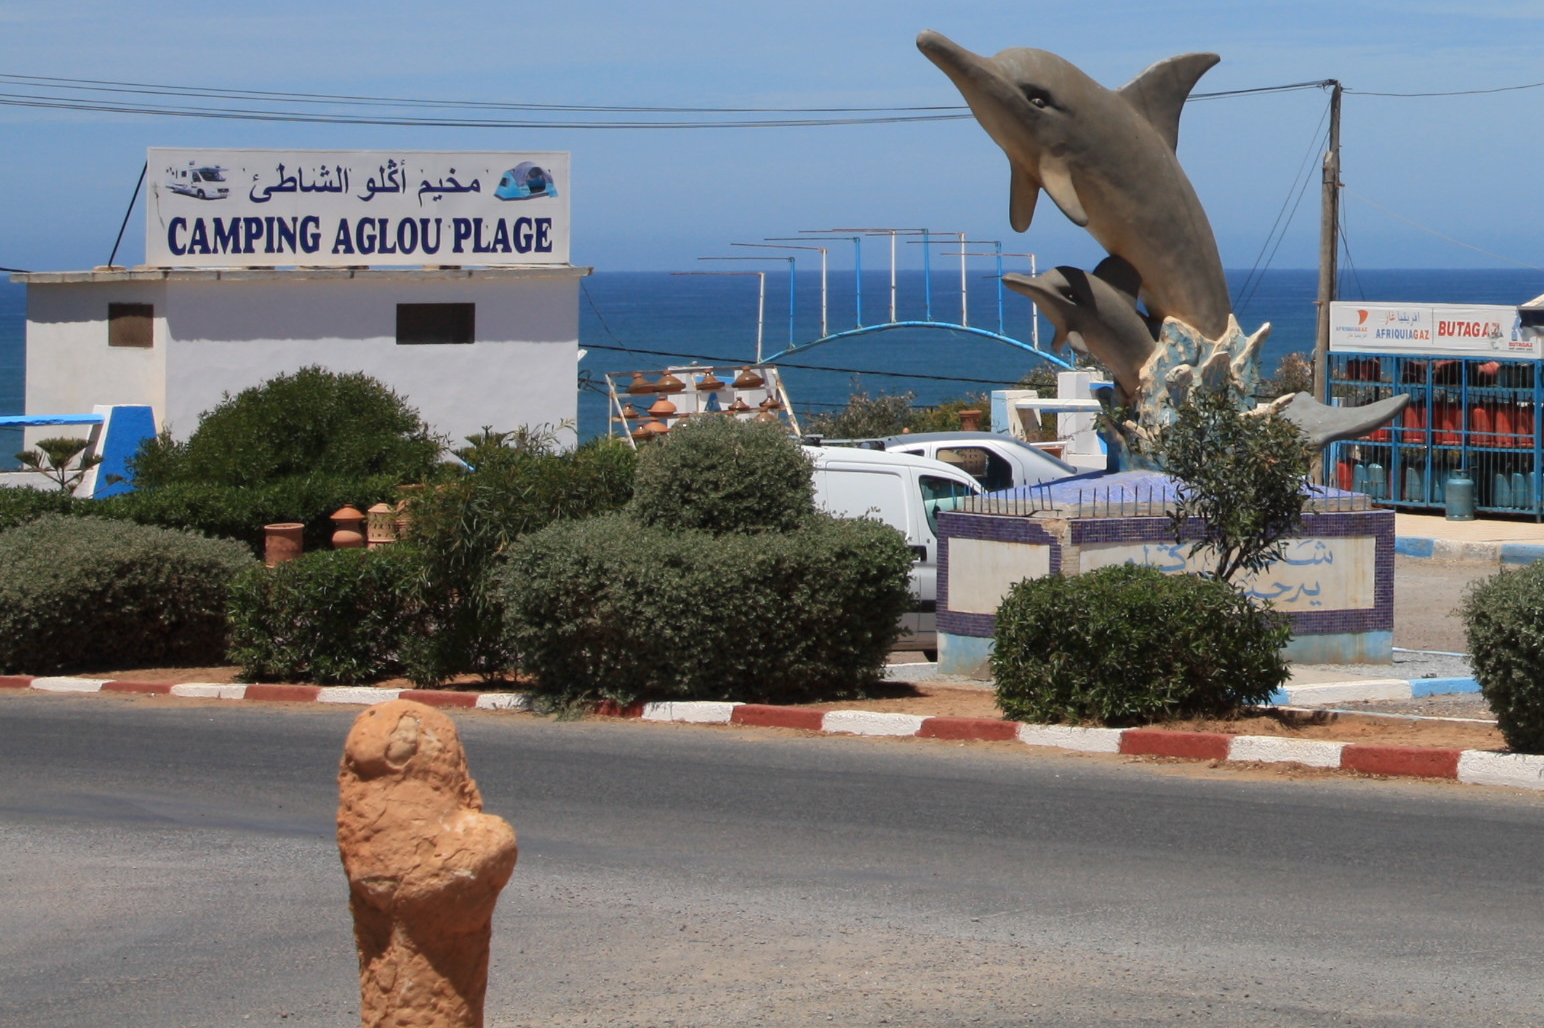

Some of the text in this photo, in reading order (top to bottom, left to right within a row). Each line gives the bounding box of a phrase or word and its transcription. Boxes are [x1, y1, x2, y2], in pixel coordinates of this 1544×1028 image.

[249, 162, 349, 204] الشاطئ
[418, 168, 481, 208] مخيم
[167, 215, 553, 256] CAMPING AGLOU PLAGE
[1375, 328, 1430, 340] AFRIQUIAGAZ
